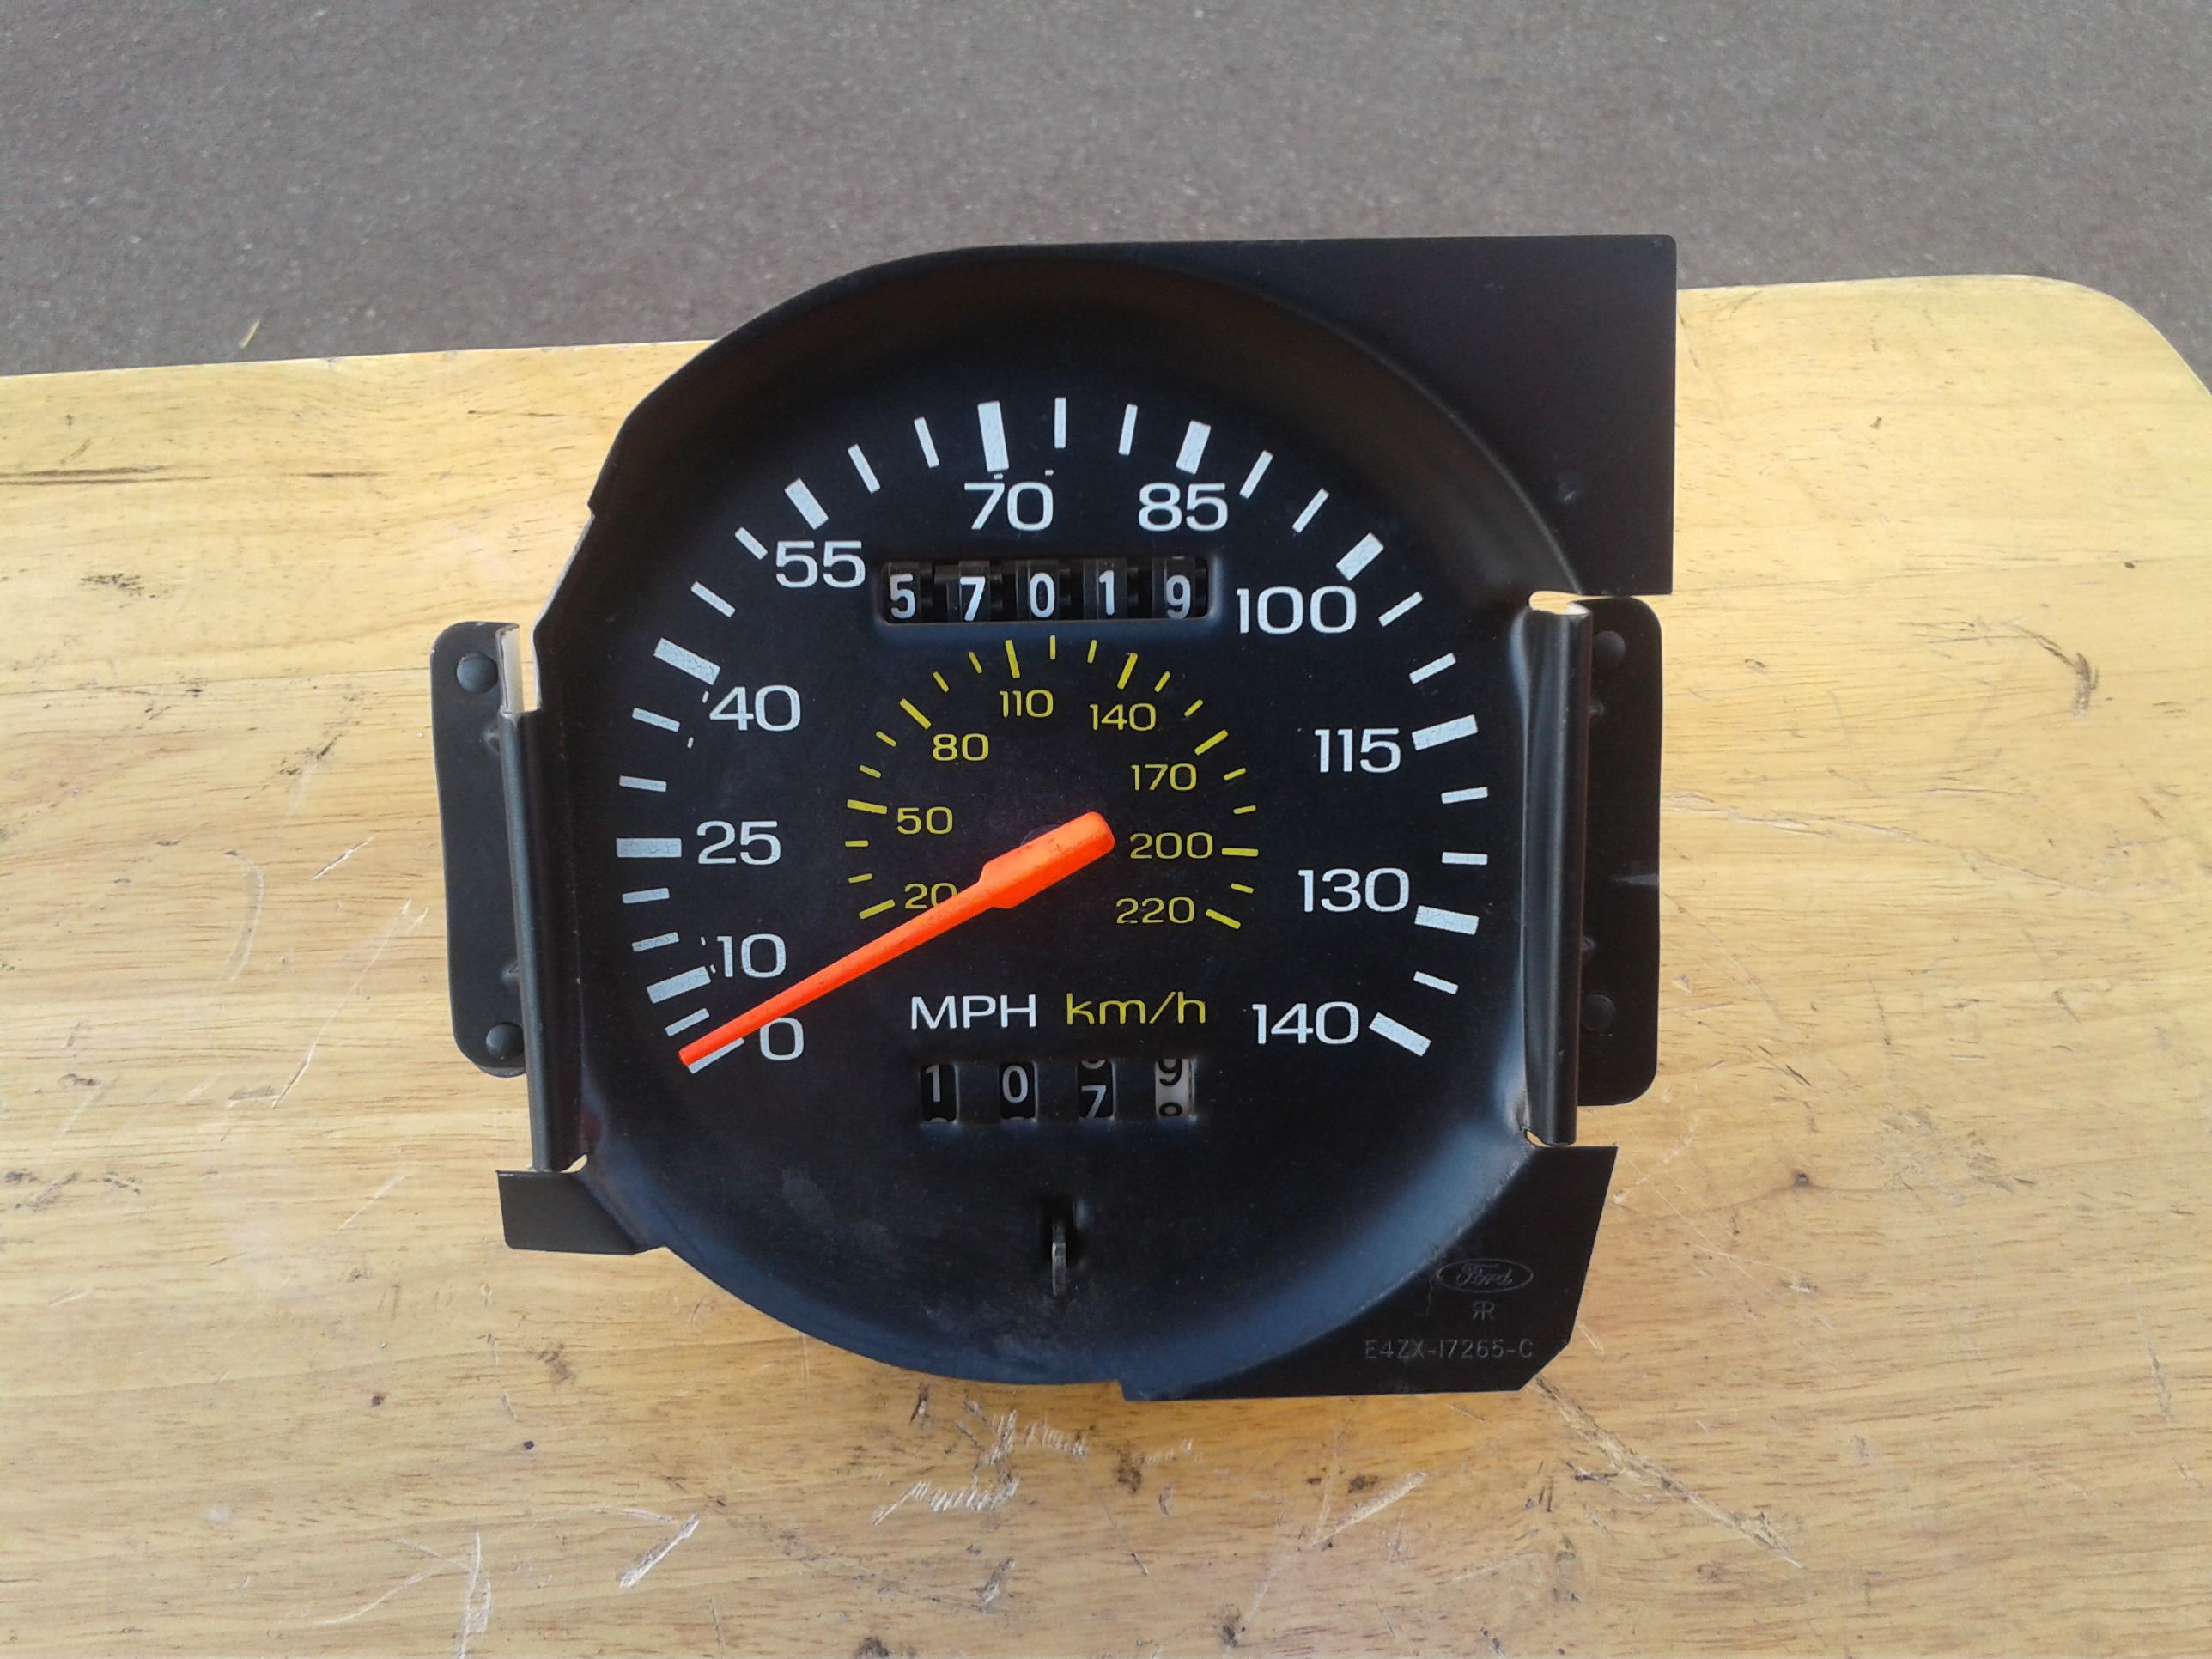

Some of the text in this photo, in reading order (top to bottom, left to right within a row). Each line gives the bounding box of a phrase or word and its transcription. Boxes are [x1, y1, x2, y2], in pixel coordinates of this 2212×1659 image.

[964, 482, 1054, 531] 70
[1139, 483, 1228, 531] 85
[776, 541, 865, 588] 55
[890, 570, 1192, 622] 57019
[1237, 586, 1357, 635] 100
[709, 685, 801, 732] 40
[1000, 690, 1054, 718] 110
[1091, 703, 1157, 732] 140
[933, 733, 989, 762] 80
[1315, 728, 1401, 774] 115
[1132, 763, 1197, 791] 170
[897, 807, 953, 835] 50
[696, 821, 781, 866] 25
[1130, 832, 1213, 860] 200
[904, 883, 958, 909] 20
[1115, 897, 1195, 924] 220
[1298, 868, 1410, 913] 130
[717, 933, 787, 978] 10
[910, 992, 1206, 1030] MPH km/h
[1252, 1002, 1359, 1045] 140
[759, 1017, 805, 1061] 0
[1364, 1339, 1533, 1360] E4ZX-17265-C
